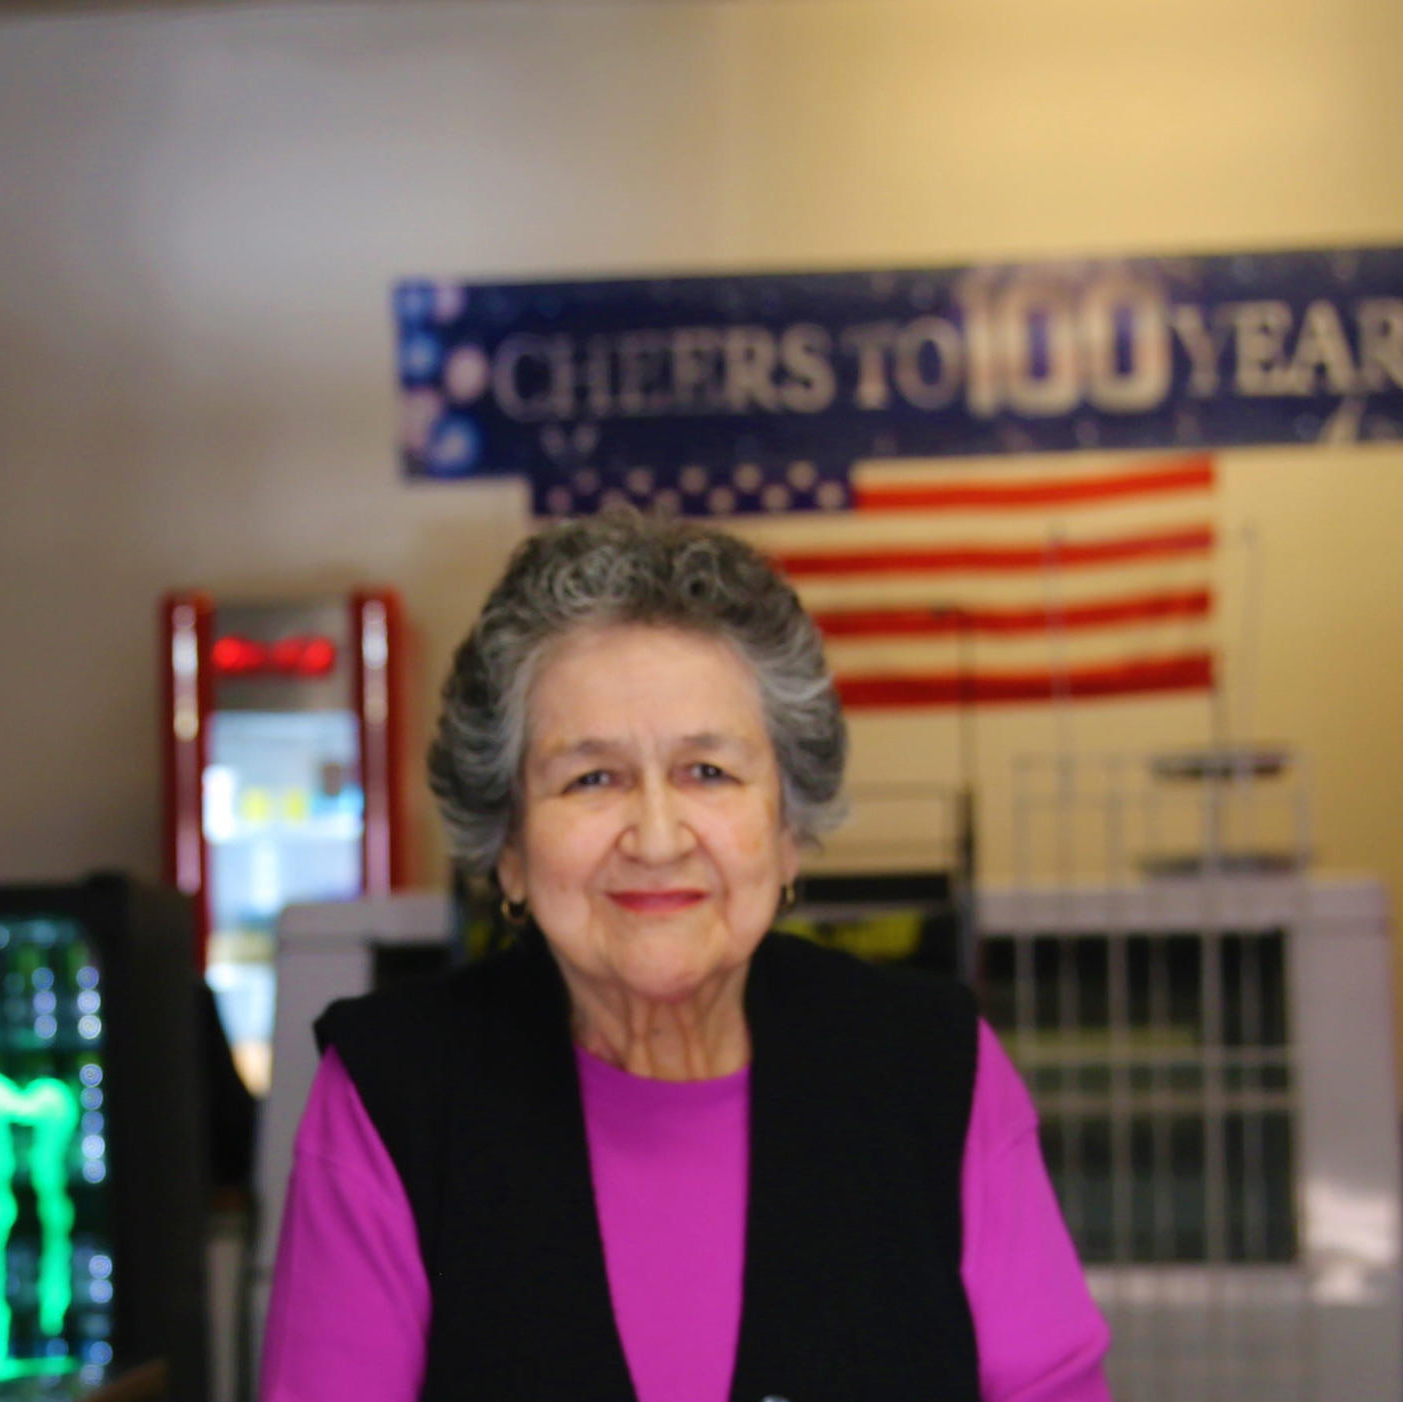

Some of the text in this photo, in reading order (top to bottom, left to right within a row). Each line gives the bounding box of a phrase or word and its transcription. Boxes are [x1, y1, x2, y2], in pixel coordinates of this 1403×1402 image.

[495, 325, 836, 421] CHEERS
[843, 315, 964, 411] TO
[958, 265, 1175, 419] 100
